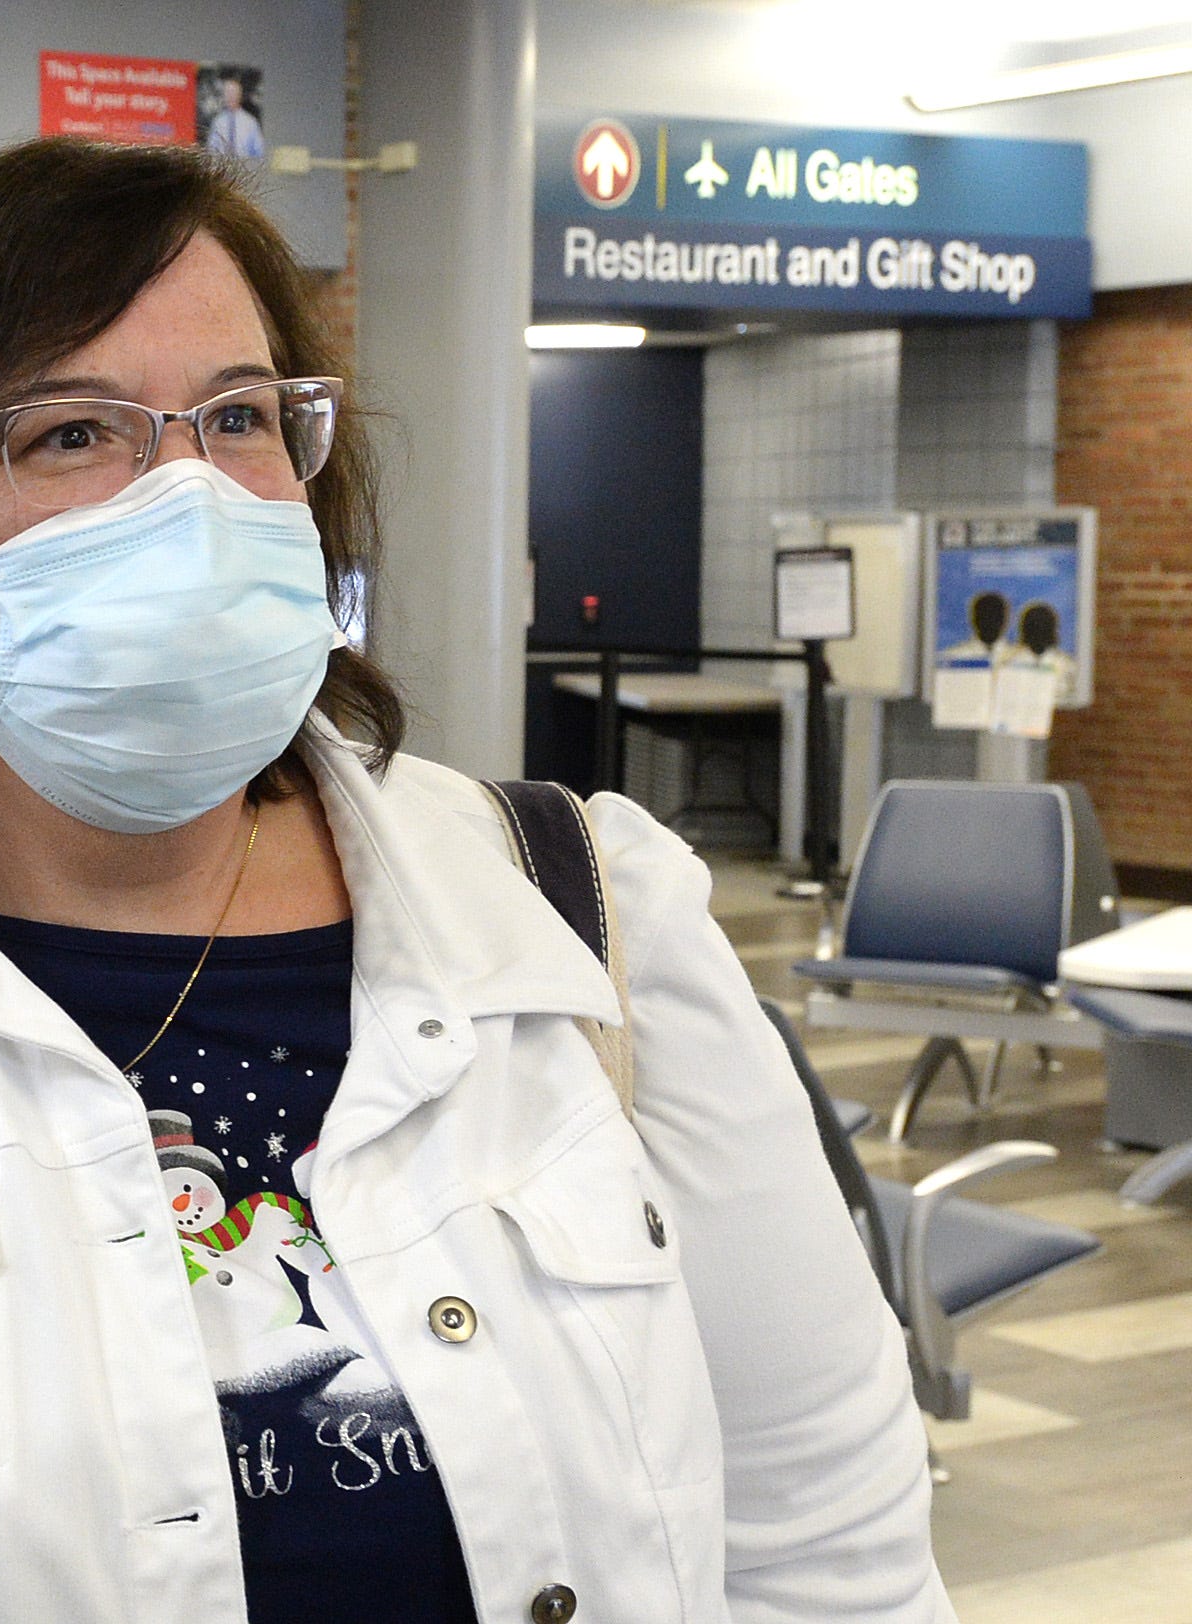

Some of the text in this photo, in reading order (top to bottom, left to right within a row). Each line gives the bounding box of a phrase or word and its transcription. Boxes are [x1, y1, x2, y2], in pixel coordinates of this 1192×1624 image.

[45, 59, 188, 90] This Space Available
[64, 86, 93, 105] Tell
[93, 93, 126, 113] your
[746, 146, 920, 207] All Gates
[563, 226, 1037, 305] Restaurant and Gift Shop
[236, 1412, 433, 1499] it Sn
